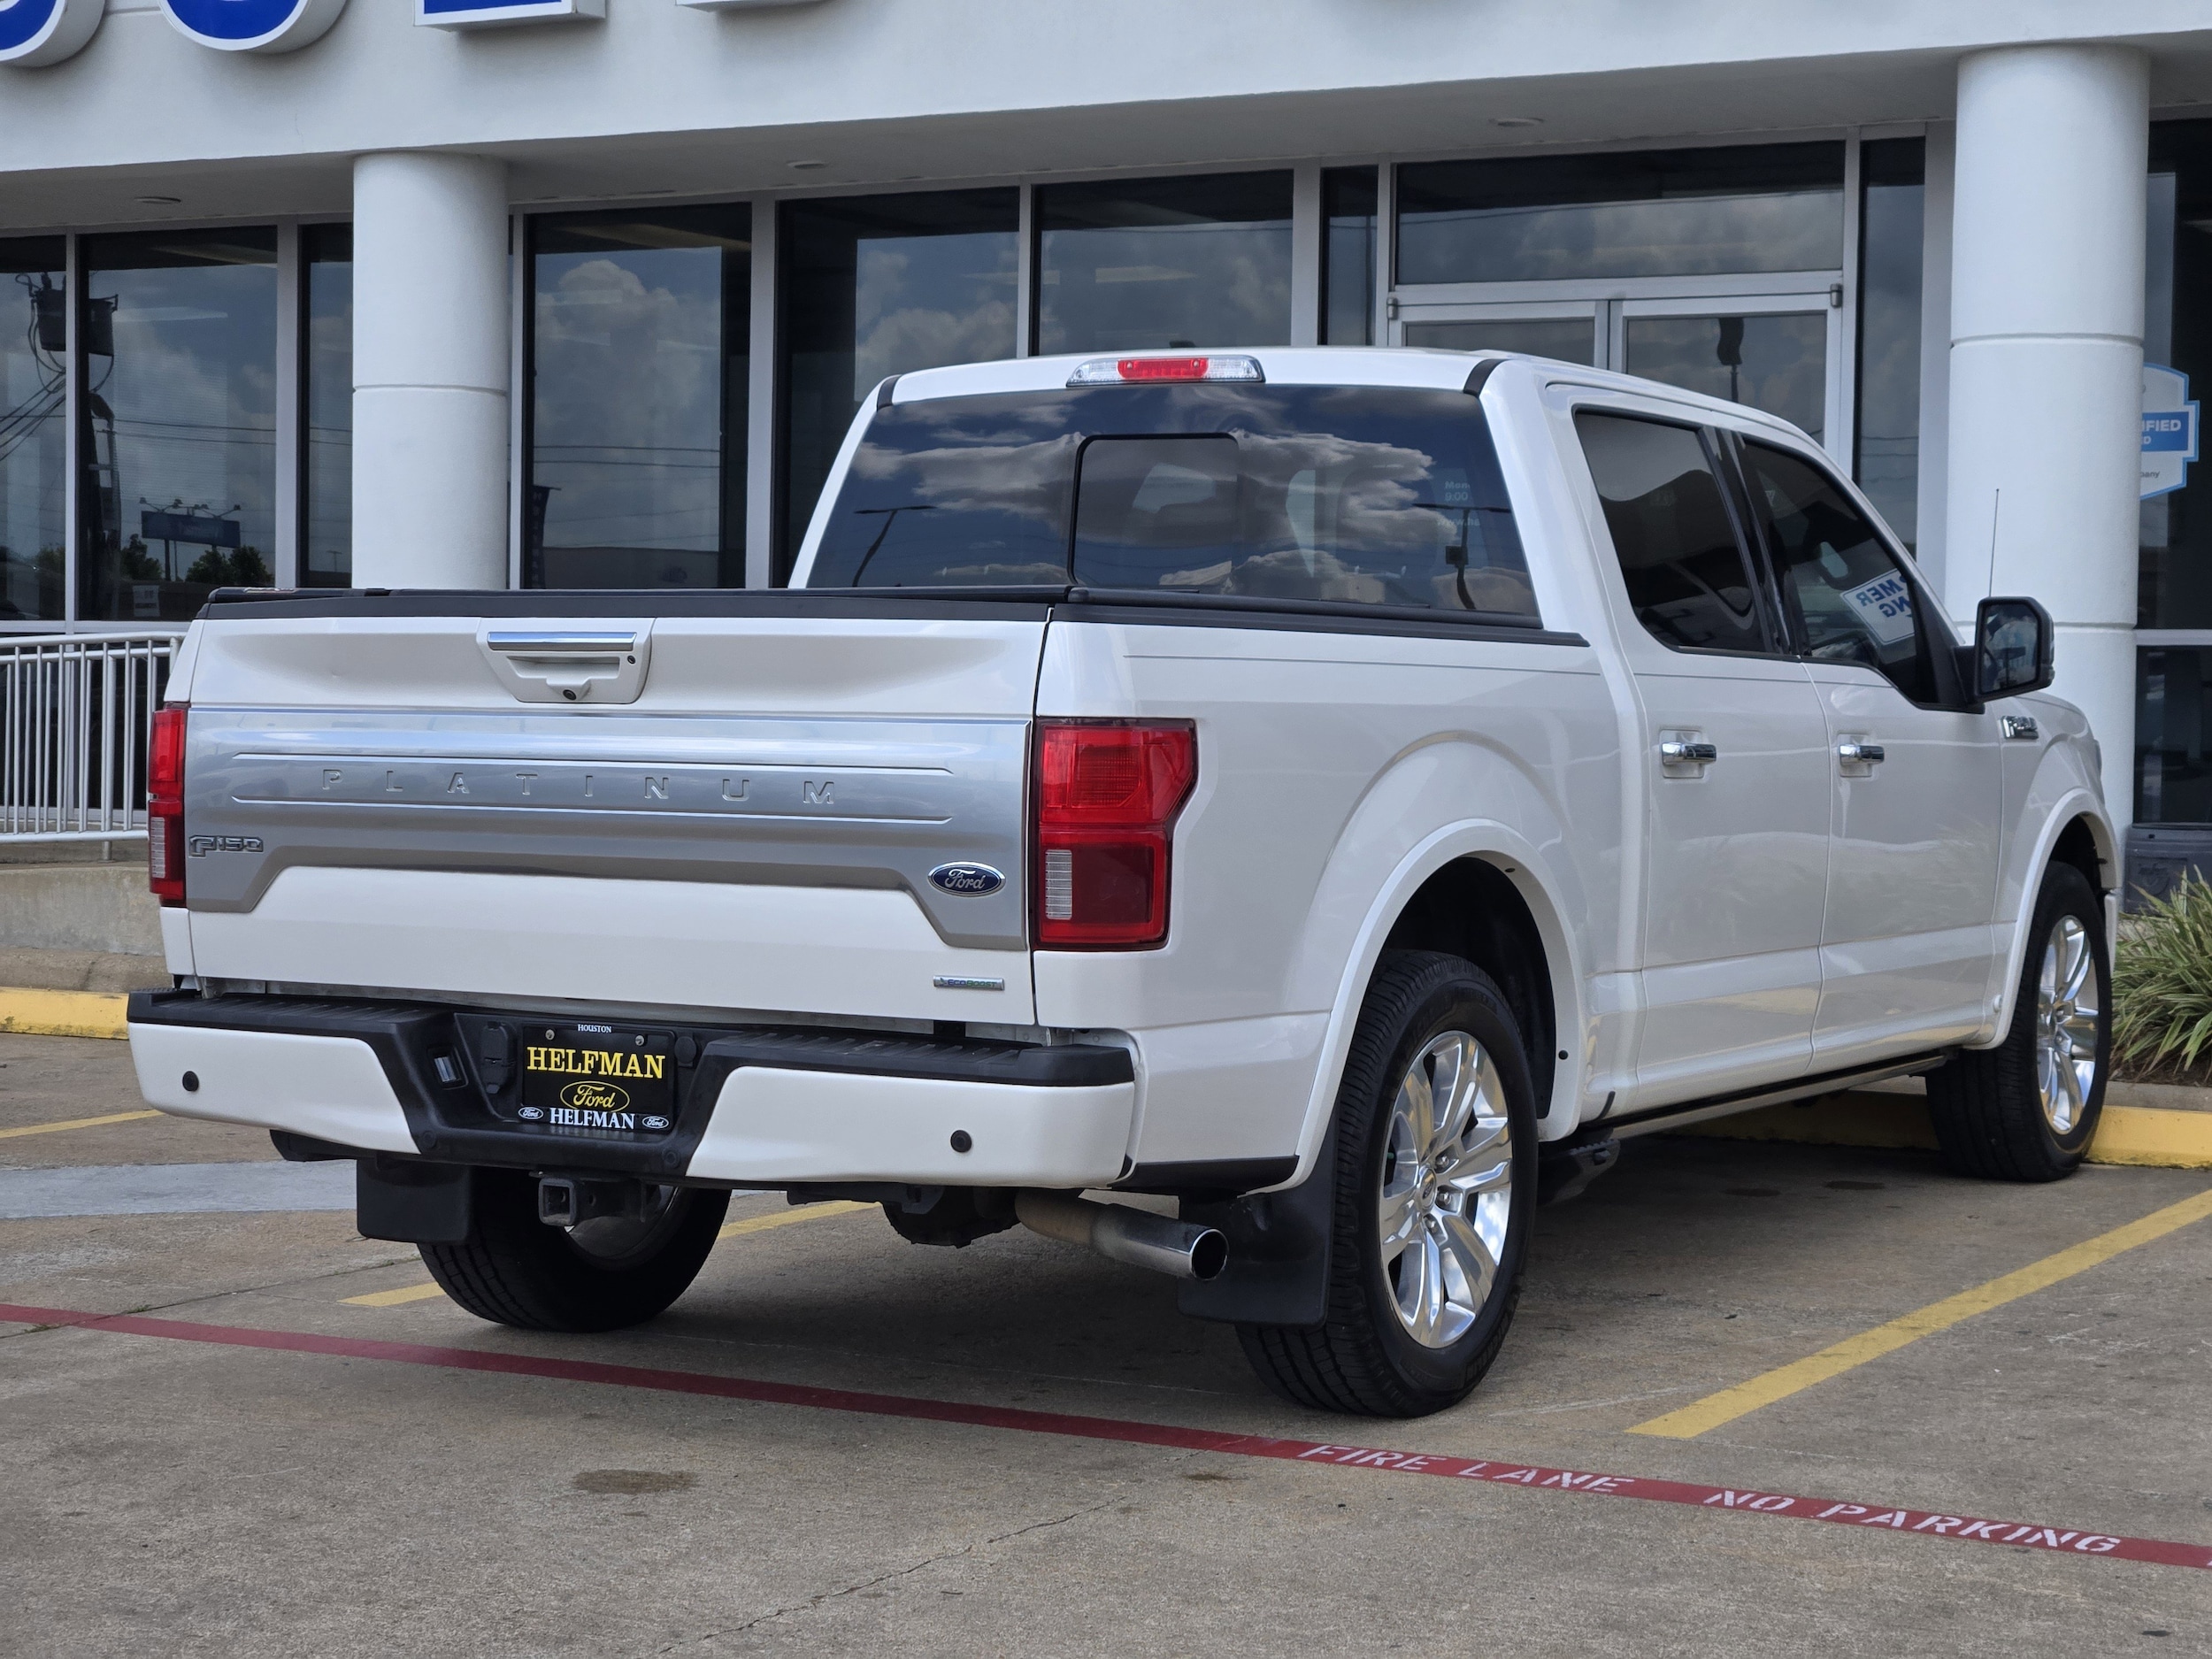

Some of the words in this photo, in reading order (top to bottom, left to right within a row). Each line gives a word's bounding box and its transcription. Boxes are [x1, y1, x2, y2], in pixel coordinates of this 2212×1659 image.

[321, 767, 835, 805] PLATINUM
[944, 868, 987, 889] Ford
[577, 1023, 613, 1033] HOUSTON
[526, 1046, 666, 1079] HELFMAN
[572, 1084, 617, 1108] Ford
[549, 1107, 636, 1130] HELFMAN
[1297, 1444, 1448, 1471] FIRE
[1458, 1461, 1636, 1493] LANE
[1702, 1489, 1795, 1512] NO
[1814, 1502, 2122, 1553] PARKING
